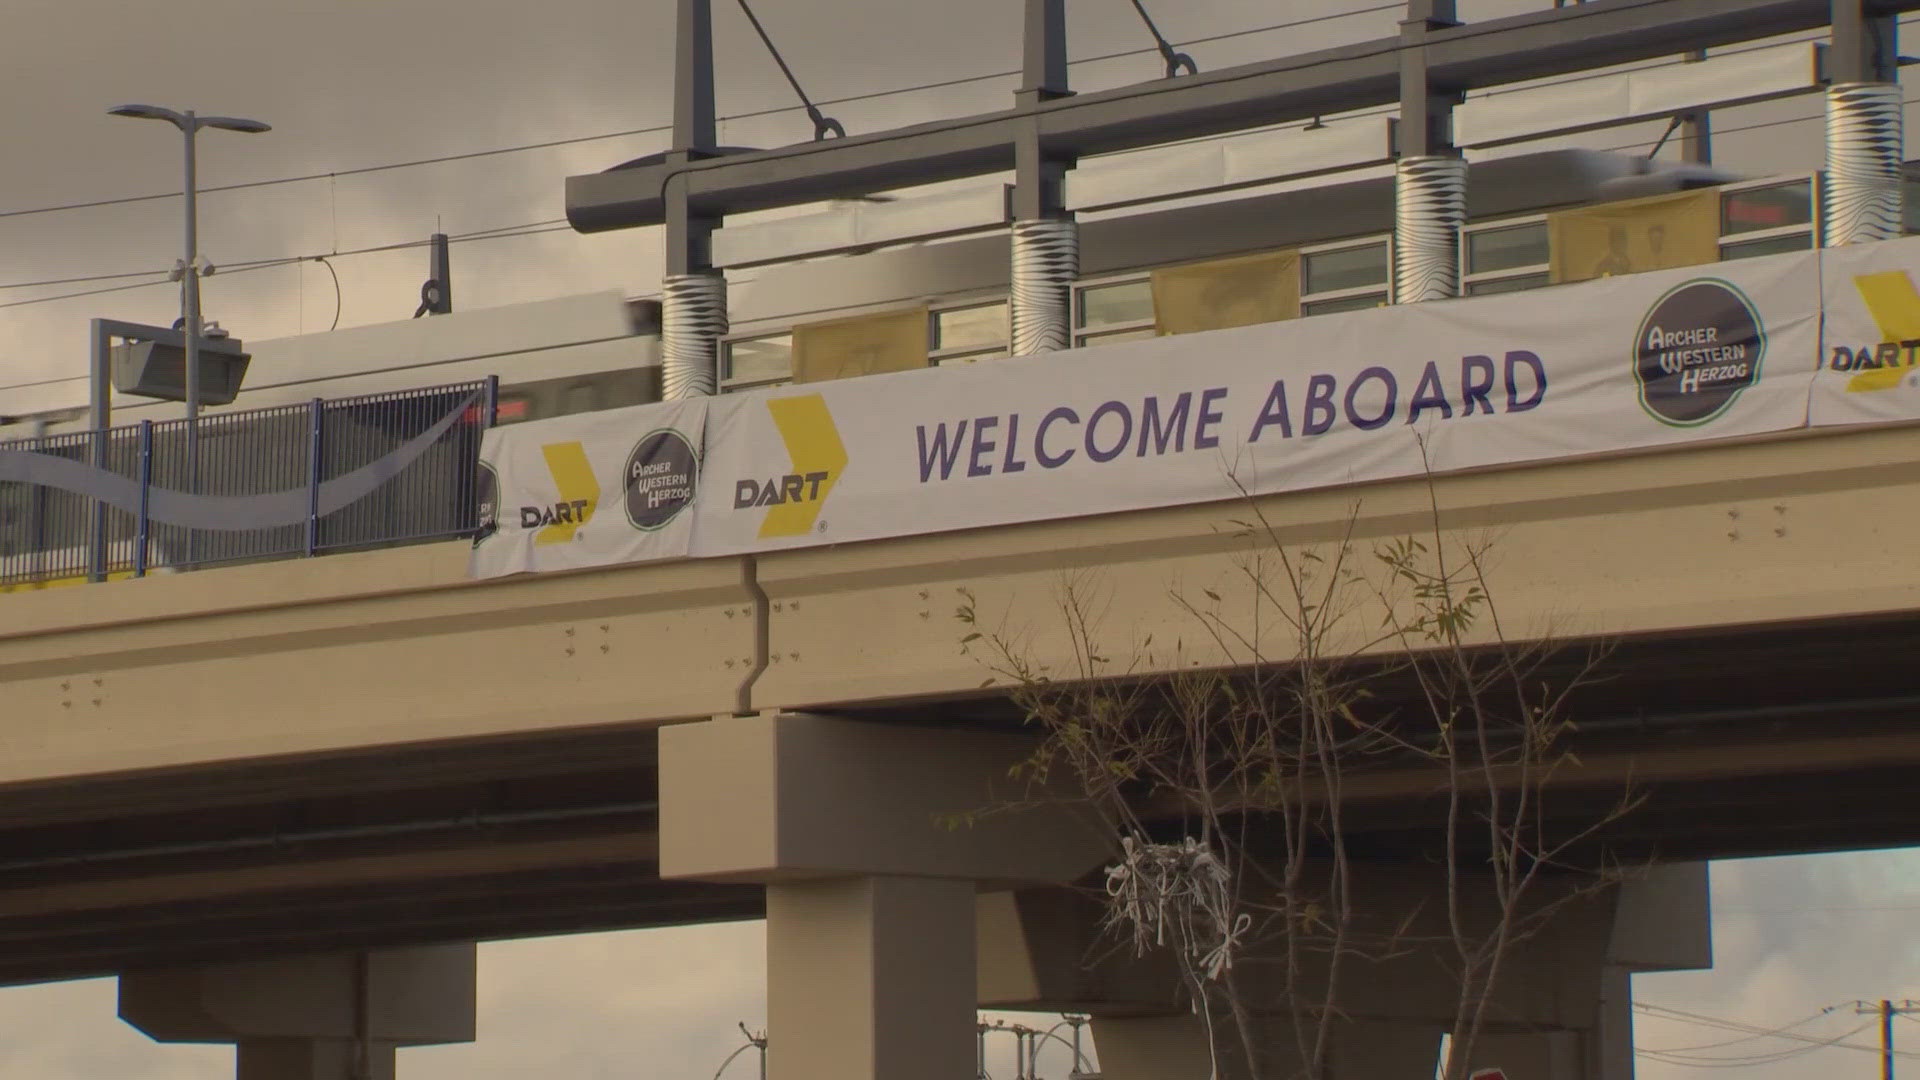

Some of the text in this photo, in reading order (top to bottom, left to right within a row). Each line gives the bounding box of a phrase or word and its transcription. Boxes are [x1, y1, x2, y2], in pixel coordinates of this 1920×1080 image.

[1648, 326, 1717, 349] ARCHER
[1660, 344, 1745, 373] WESTERN
[1830, 339, 1920, 371] DART
[1681, 364, 1747, 393] HERZOG
[916, 350, 1547, 483] WELCOME ABOARD
[632, 461, 671, 478] ARCHER
[639, 474, 687, 494] WESTERN
[648, 488, 690, 508] HERZOG
[733, 471, 829, 510] DART
[520, 499, 588, 529] DART
